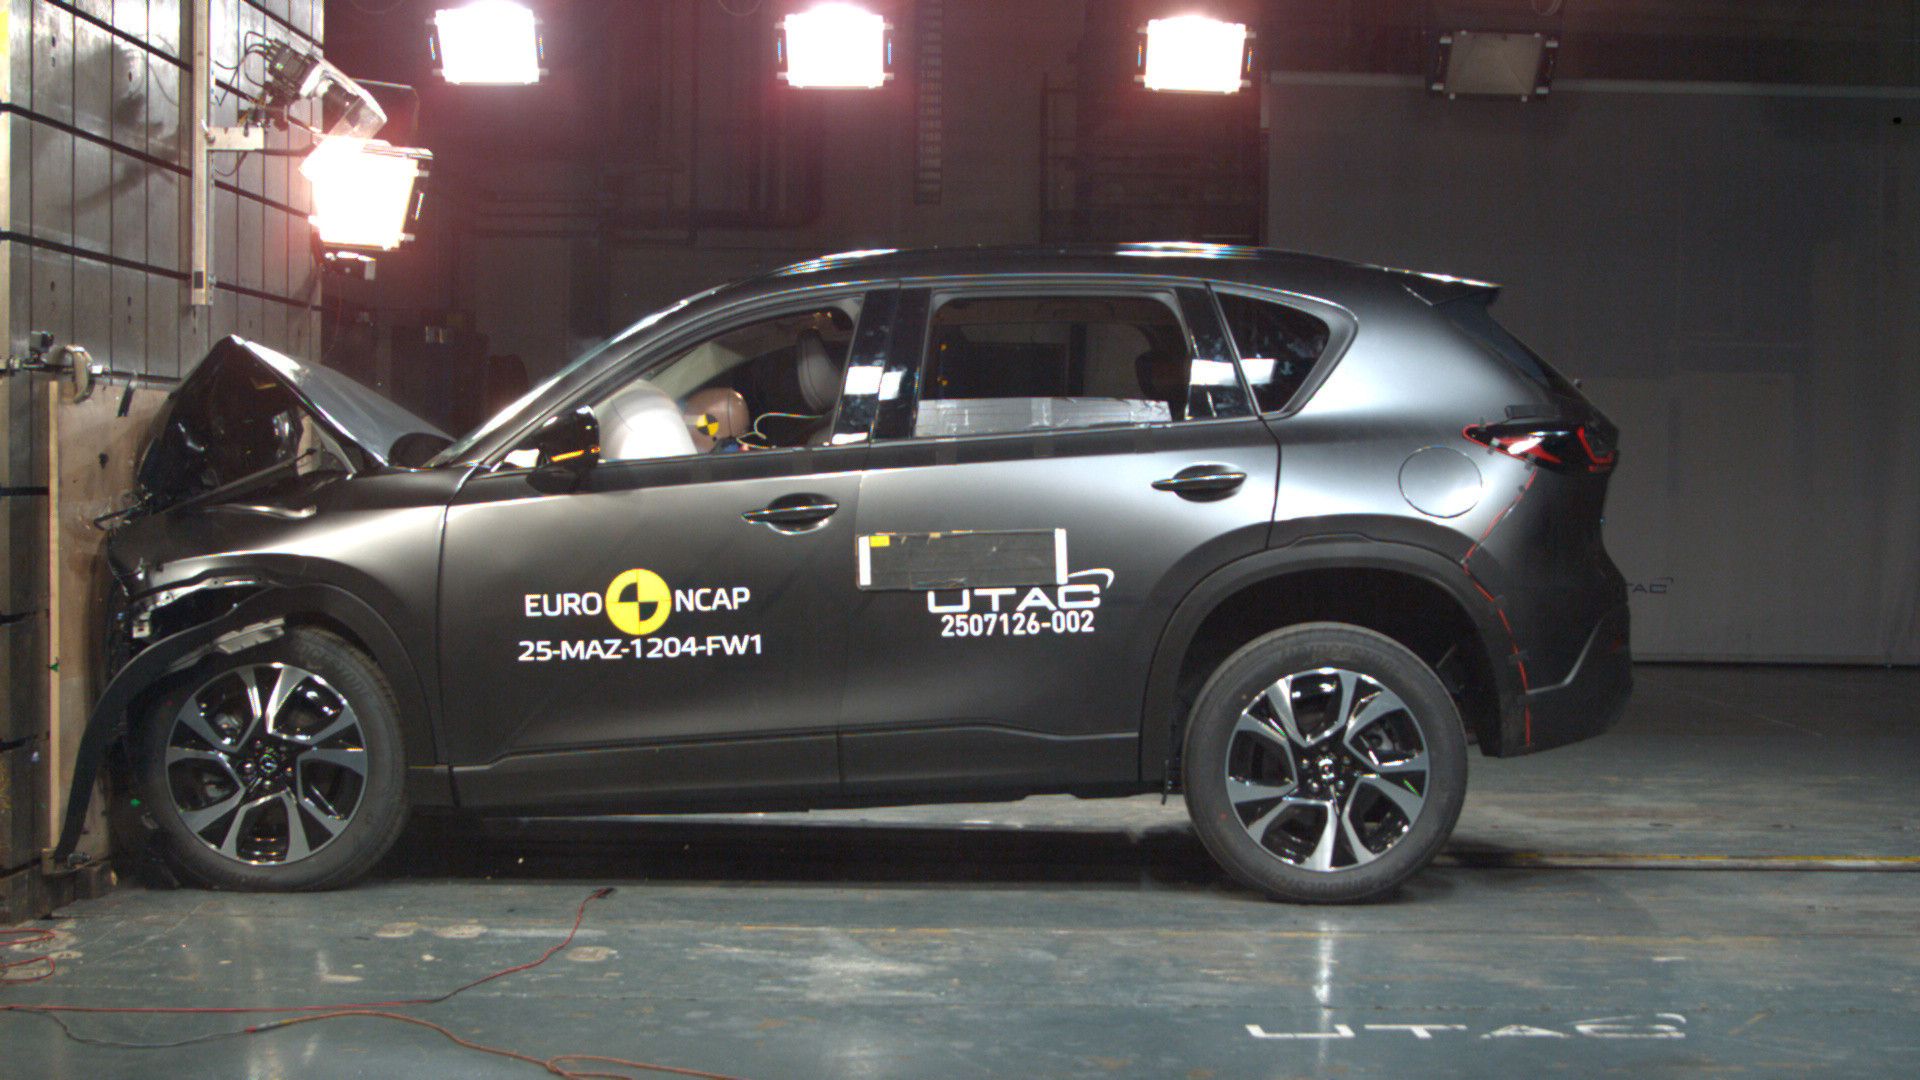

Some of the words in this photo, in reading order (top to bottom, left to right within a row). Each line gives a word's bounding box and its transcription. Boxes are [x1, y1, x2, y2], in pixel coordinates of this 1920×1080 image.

[524, 591, 603, 618] EURO
[674, 586, 751, 613] NCAP
[926, 585, 1102, 614] UTAC
[940, 610, 1095, 638] 2507126-002
[517, 632, 763, 662] 25-MAZ-1204-FW1
[1245, 1018, 1687, 1040] UTAC
